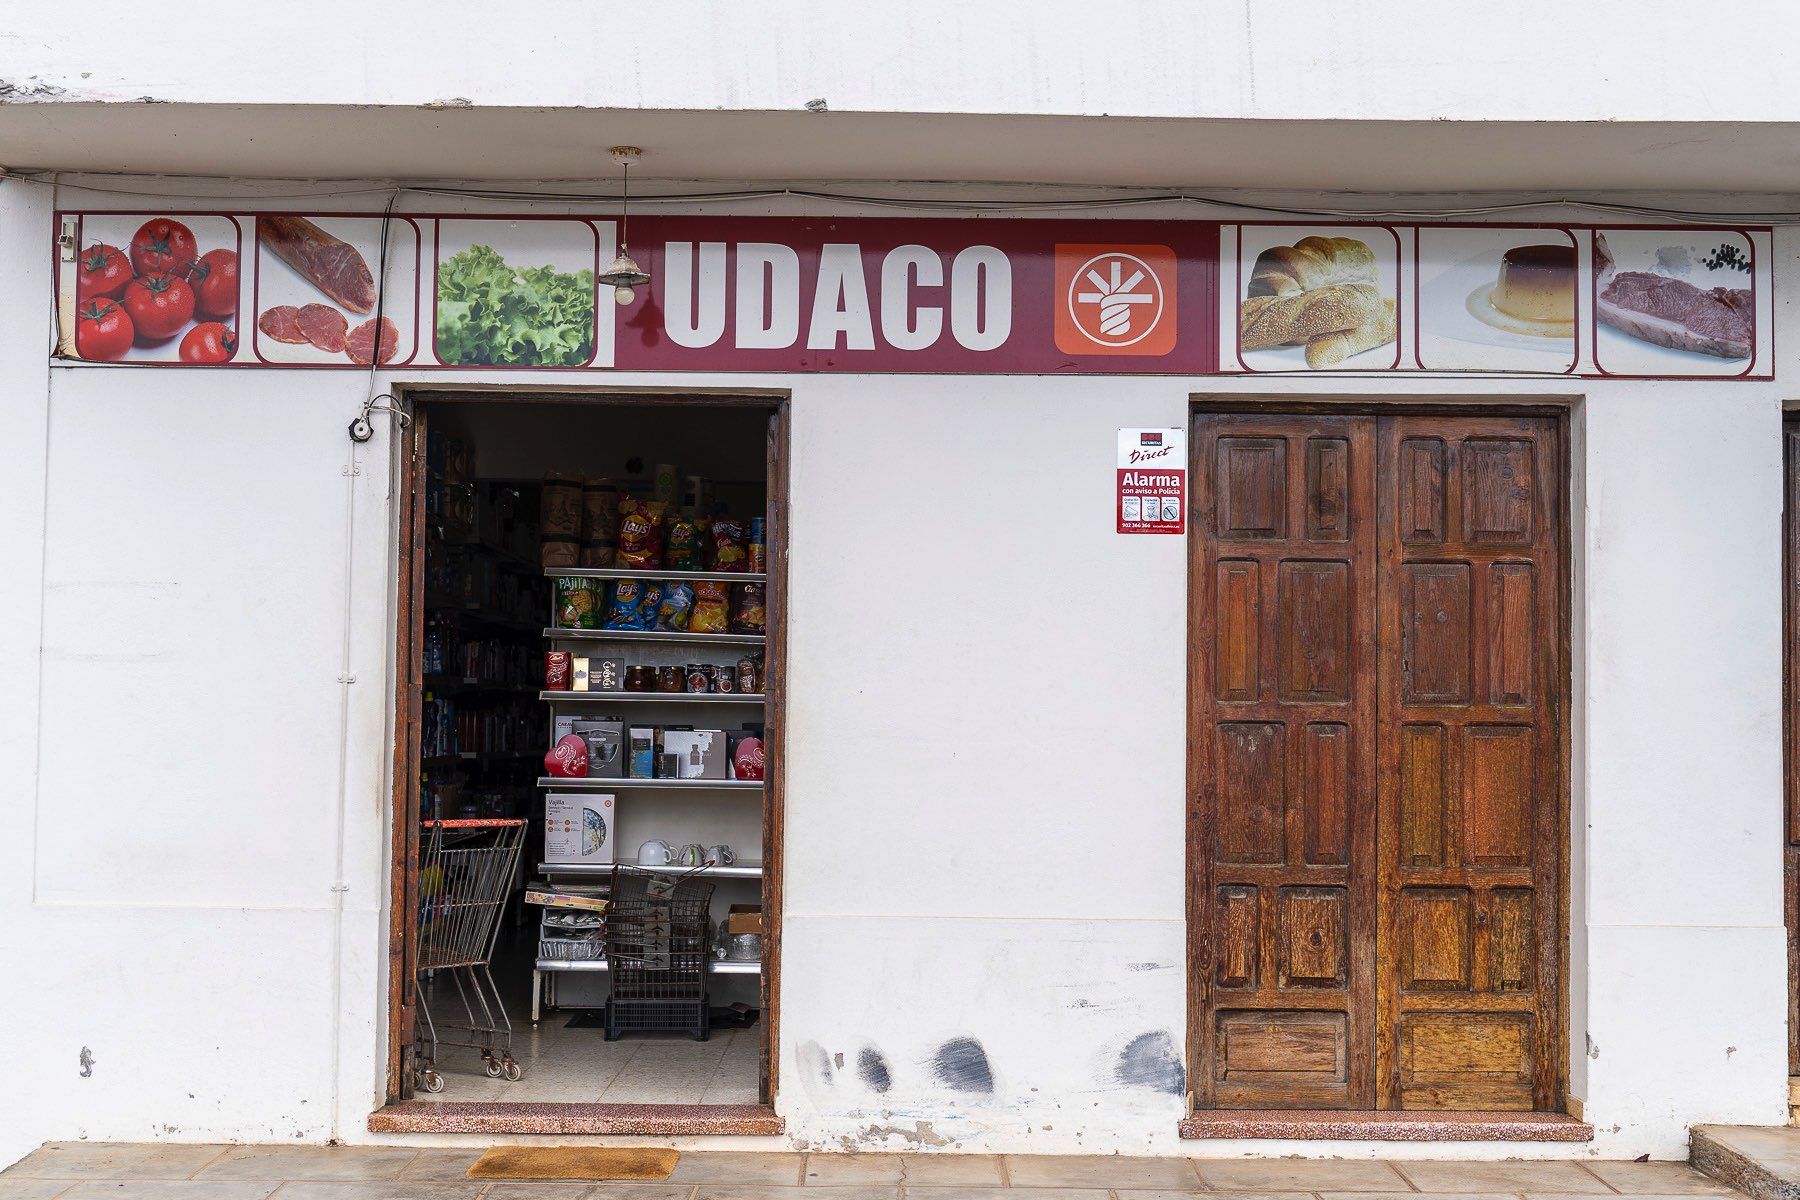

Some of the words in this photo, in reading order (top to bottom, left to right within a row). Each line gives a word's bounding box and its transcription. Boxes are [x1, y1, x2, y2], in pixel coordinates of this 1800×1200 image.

[664, 241, 1013, 351] UDACO
[1129, 446, 1174, 464] Direct
[1122, 471, 1181, 487] Alarma
[622, 520, 649, 536] Lay's
[616, 582, 638, 597] Lay's
